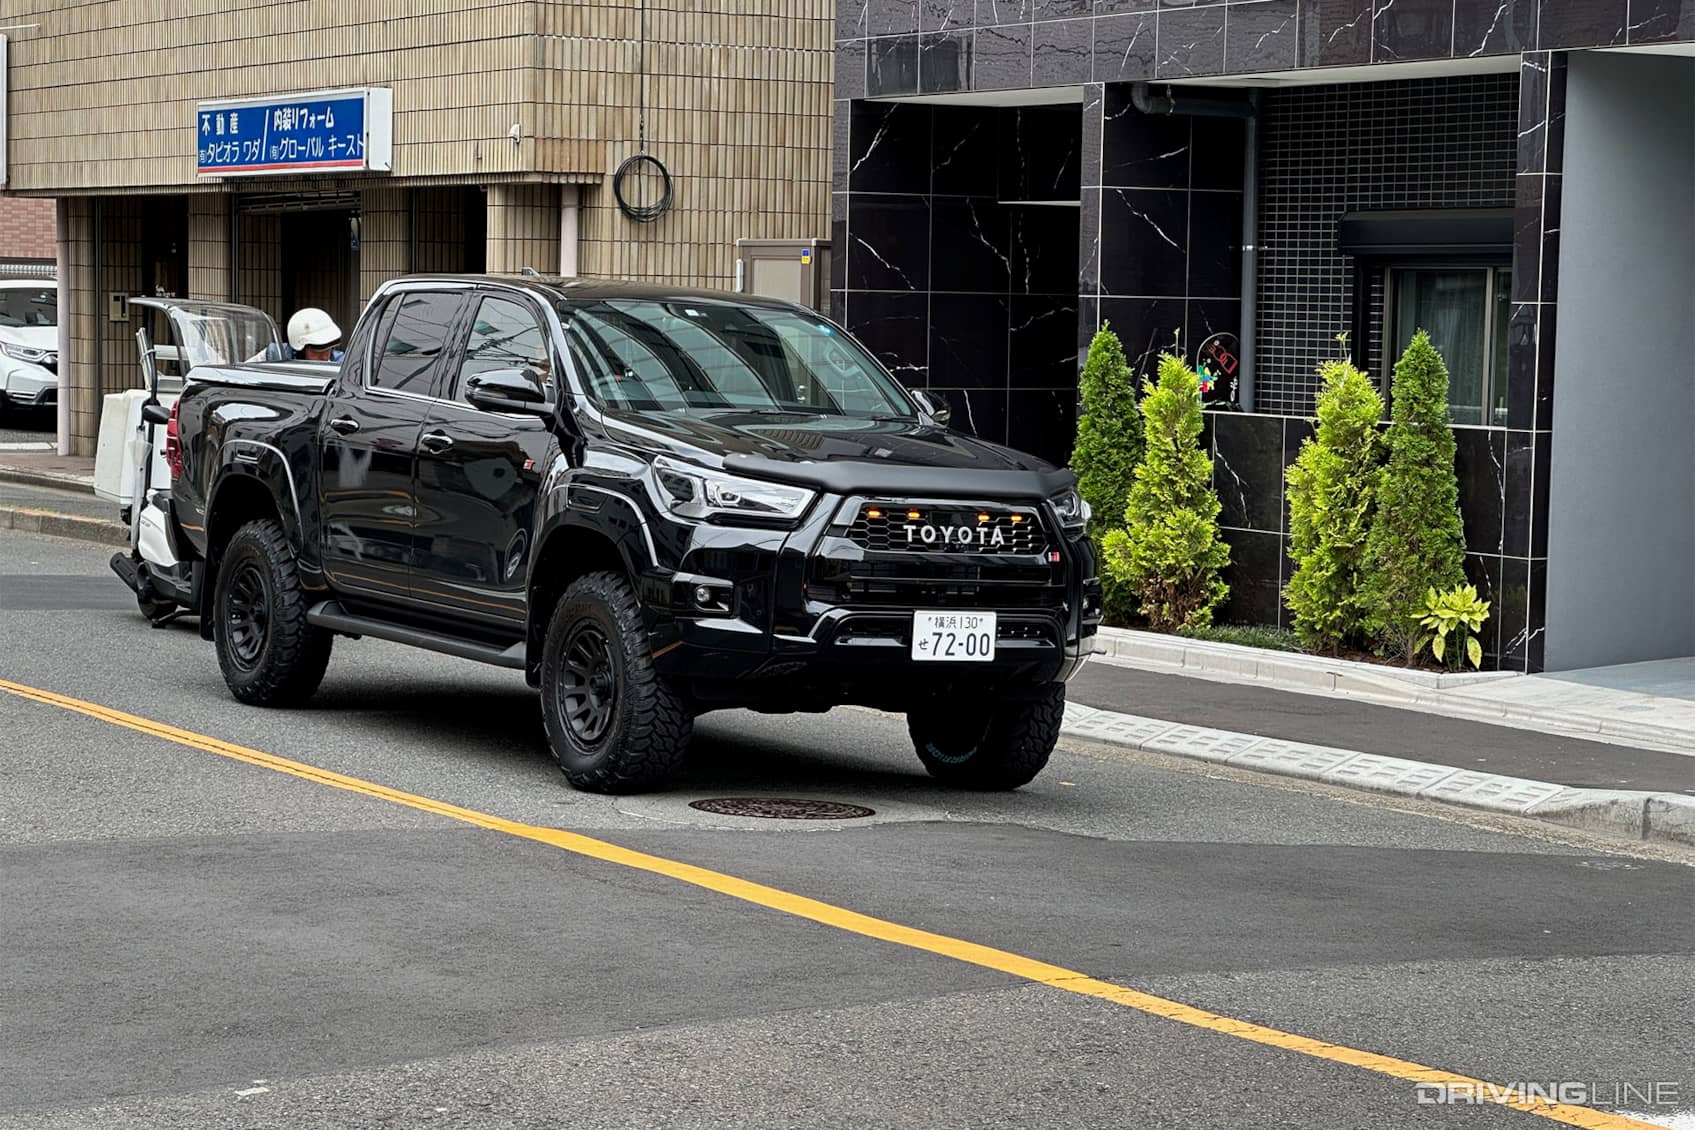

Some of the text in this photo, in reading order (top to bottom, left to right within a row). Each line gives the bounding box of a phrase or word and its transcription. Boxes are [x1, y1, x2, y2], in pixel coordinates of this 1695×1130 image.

[202, 111, 239, 136] 不動産
[273, 106, 335, 131] 内装リフォーム
[903, 525, 1005, 545] TOYOTA
[932, 632, 990, 656] 72-00
